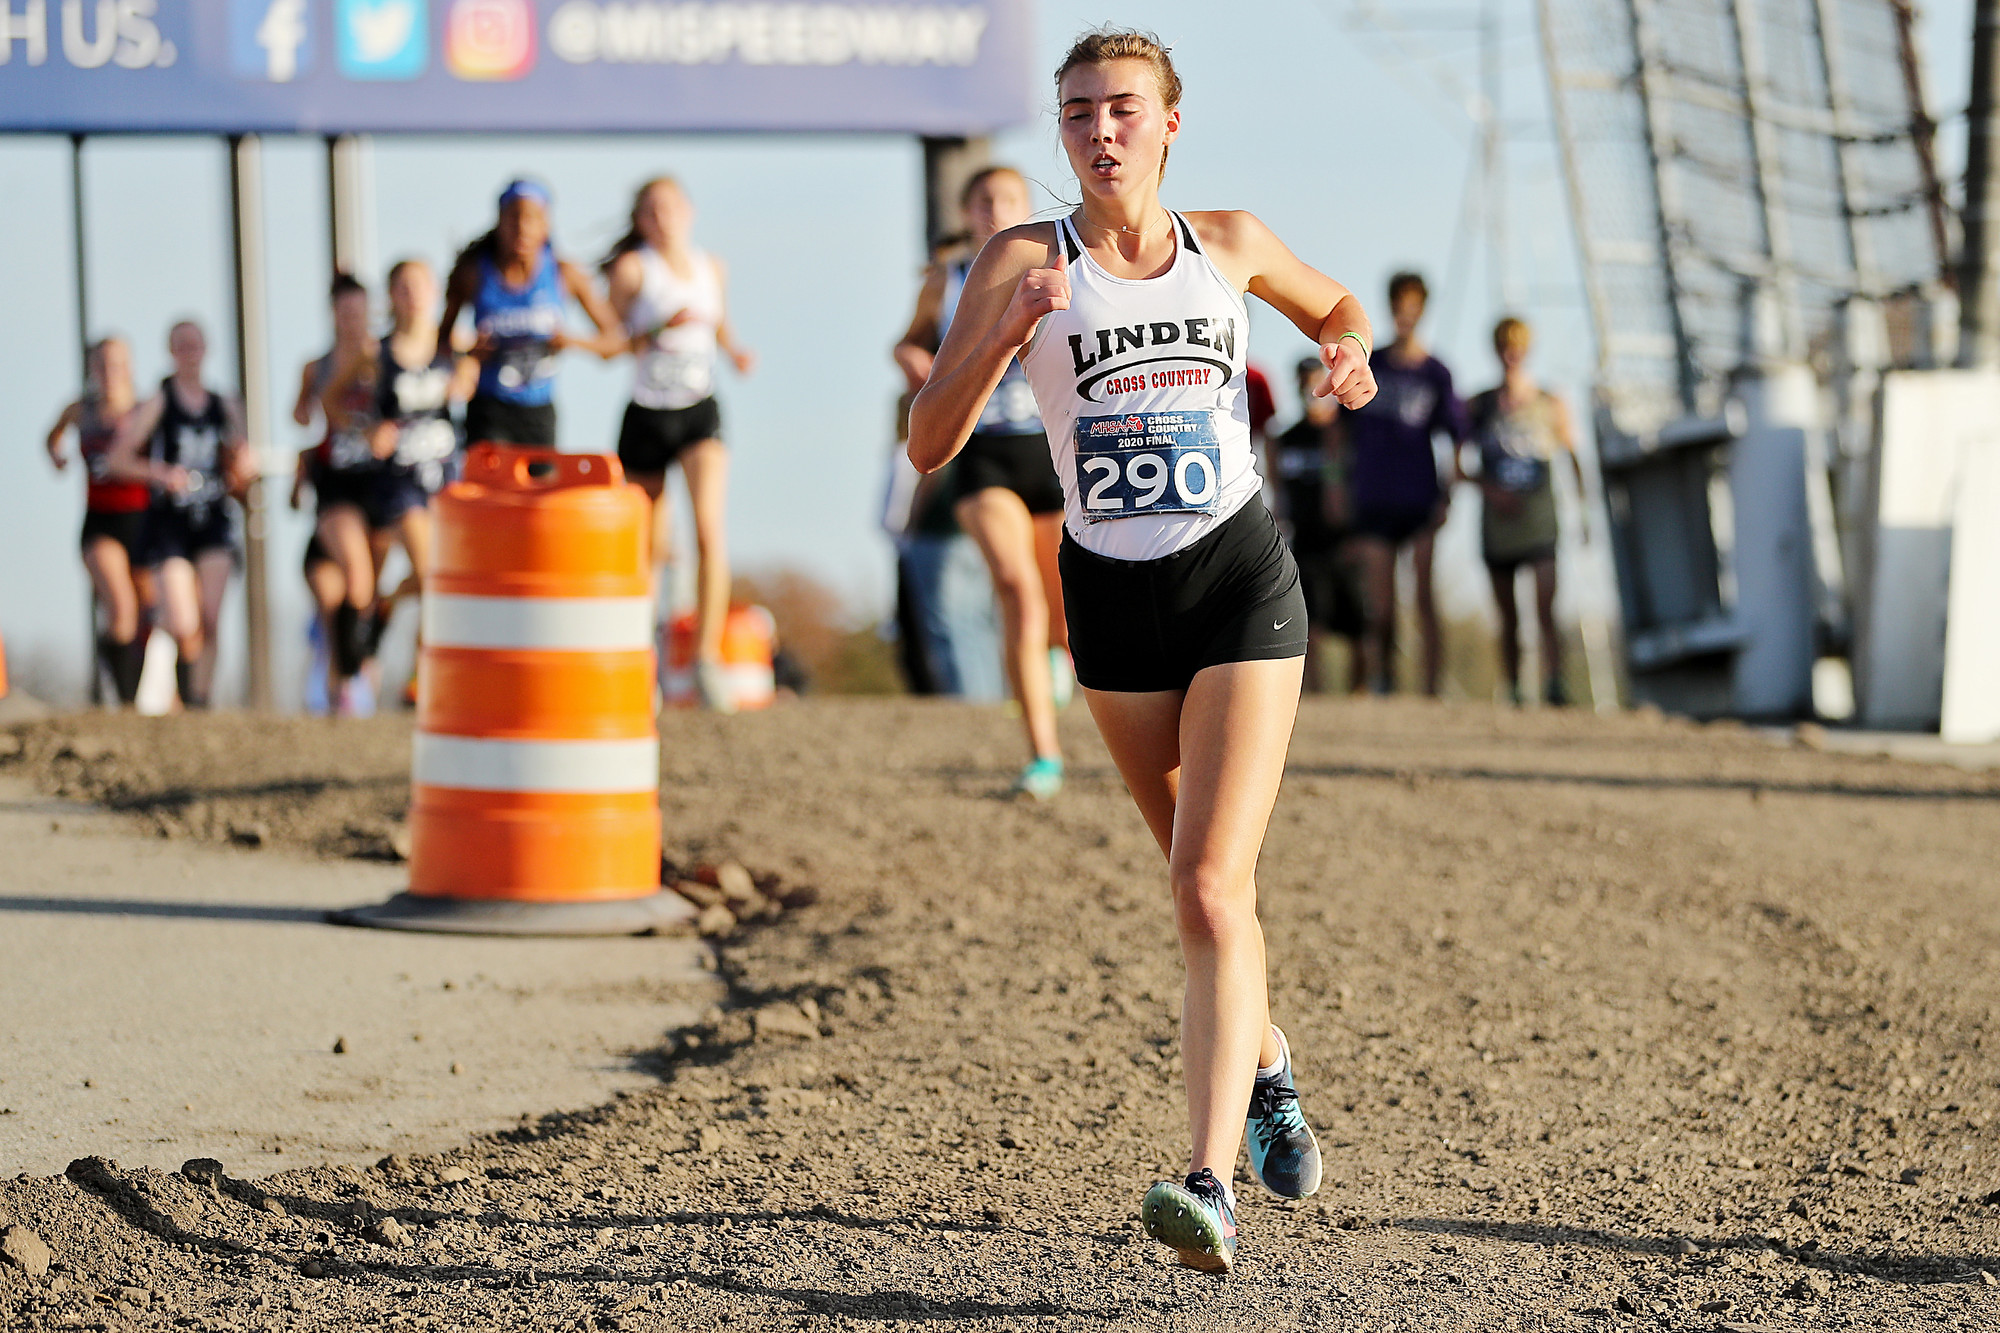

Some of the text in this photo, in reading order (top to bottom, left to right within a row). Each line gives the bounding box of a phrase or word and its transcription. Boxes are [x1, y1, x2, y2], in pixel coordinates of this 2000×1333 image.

[61, 0, 177, 69] US.
[1068, 318, 1235, 378] LINDEN
[1106, 369, 1211, 395] CROSS COUNTRY
[1147, 415, 1184, 425] CROSS
[1147, 424, 1198, 434] COUNTRY
[1117, 437, 1144, 448] 2020
[1145, 434, 1175, 446] FINAL
[1082, 451, 1217, 510] 290
